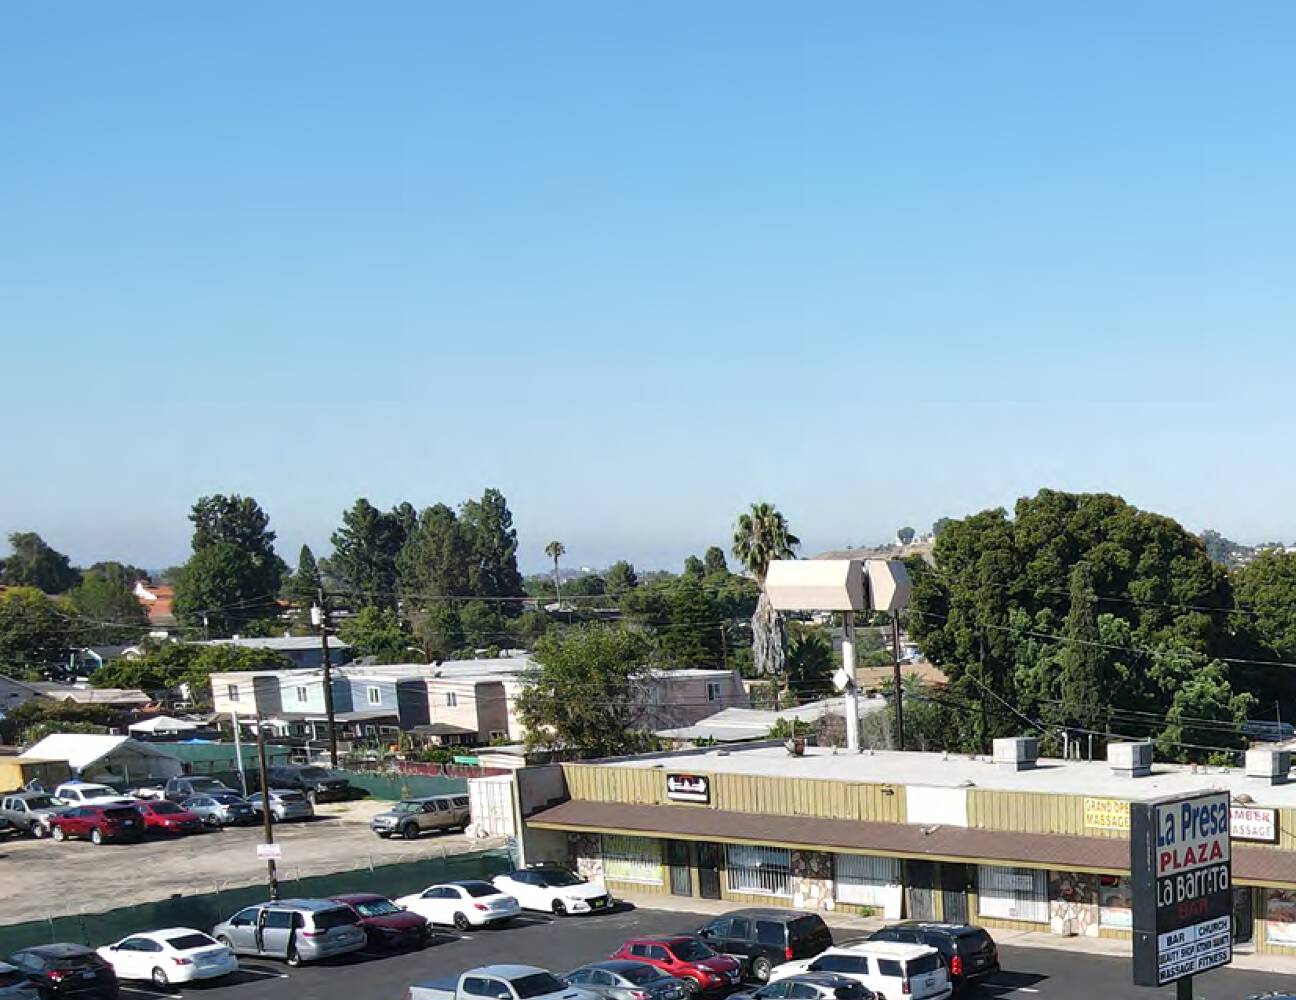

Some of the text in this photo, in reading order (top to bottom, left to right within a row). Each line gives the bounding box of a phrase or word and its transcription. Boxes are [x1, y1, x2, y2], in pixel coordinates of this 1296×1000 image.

[1156, 802, 1227, 847] La Presa
[1232, 825, 1271, 836] ASSAGE
[1160, 839, 1223, 873] PLAZA
[1157, 879, 1173, 908] La
[1177, 897, 1210, 920] BAR
[1166, 932, 1185, 947] BAR
[1199, 919, 1228, 936] CHURCH
[1160, 950, 1228, 981] MASSAGE FITNESS
